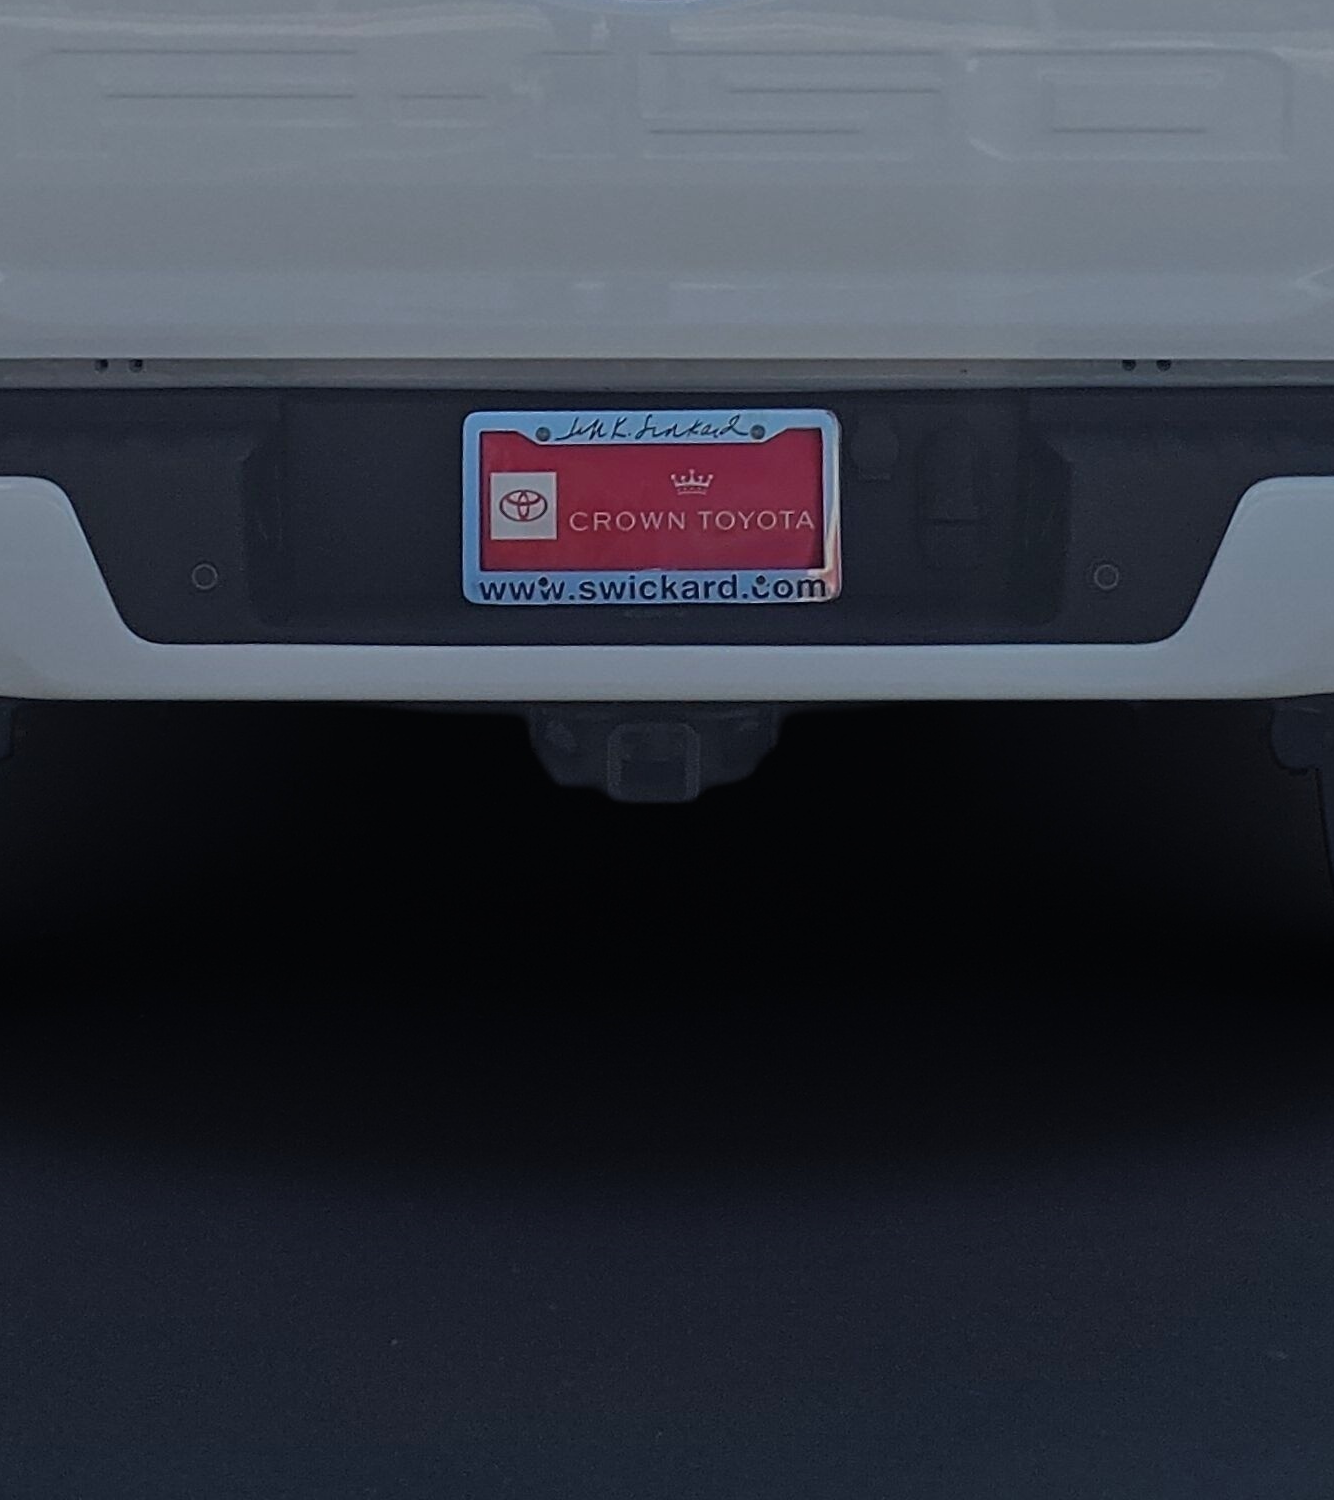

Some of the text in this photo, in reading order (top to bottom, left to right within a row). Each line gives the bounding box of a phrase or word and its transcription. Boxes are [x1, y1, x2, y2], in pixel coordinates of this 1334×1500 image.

[569, 509, 815, 532] CROWN TOYOTA
[479, 574, 827, 601] www.swickard.com
